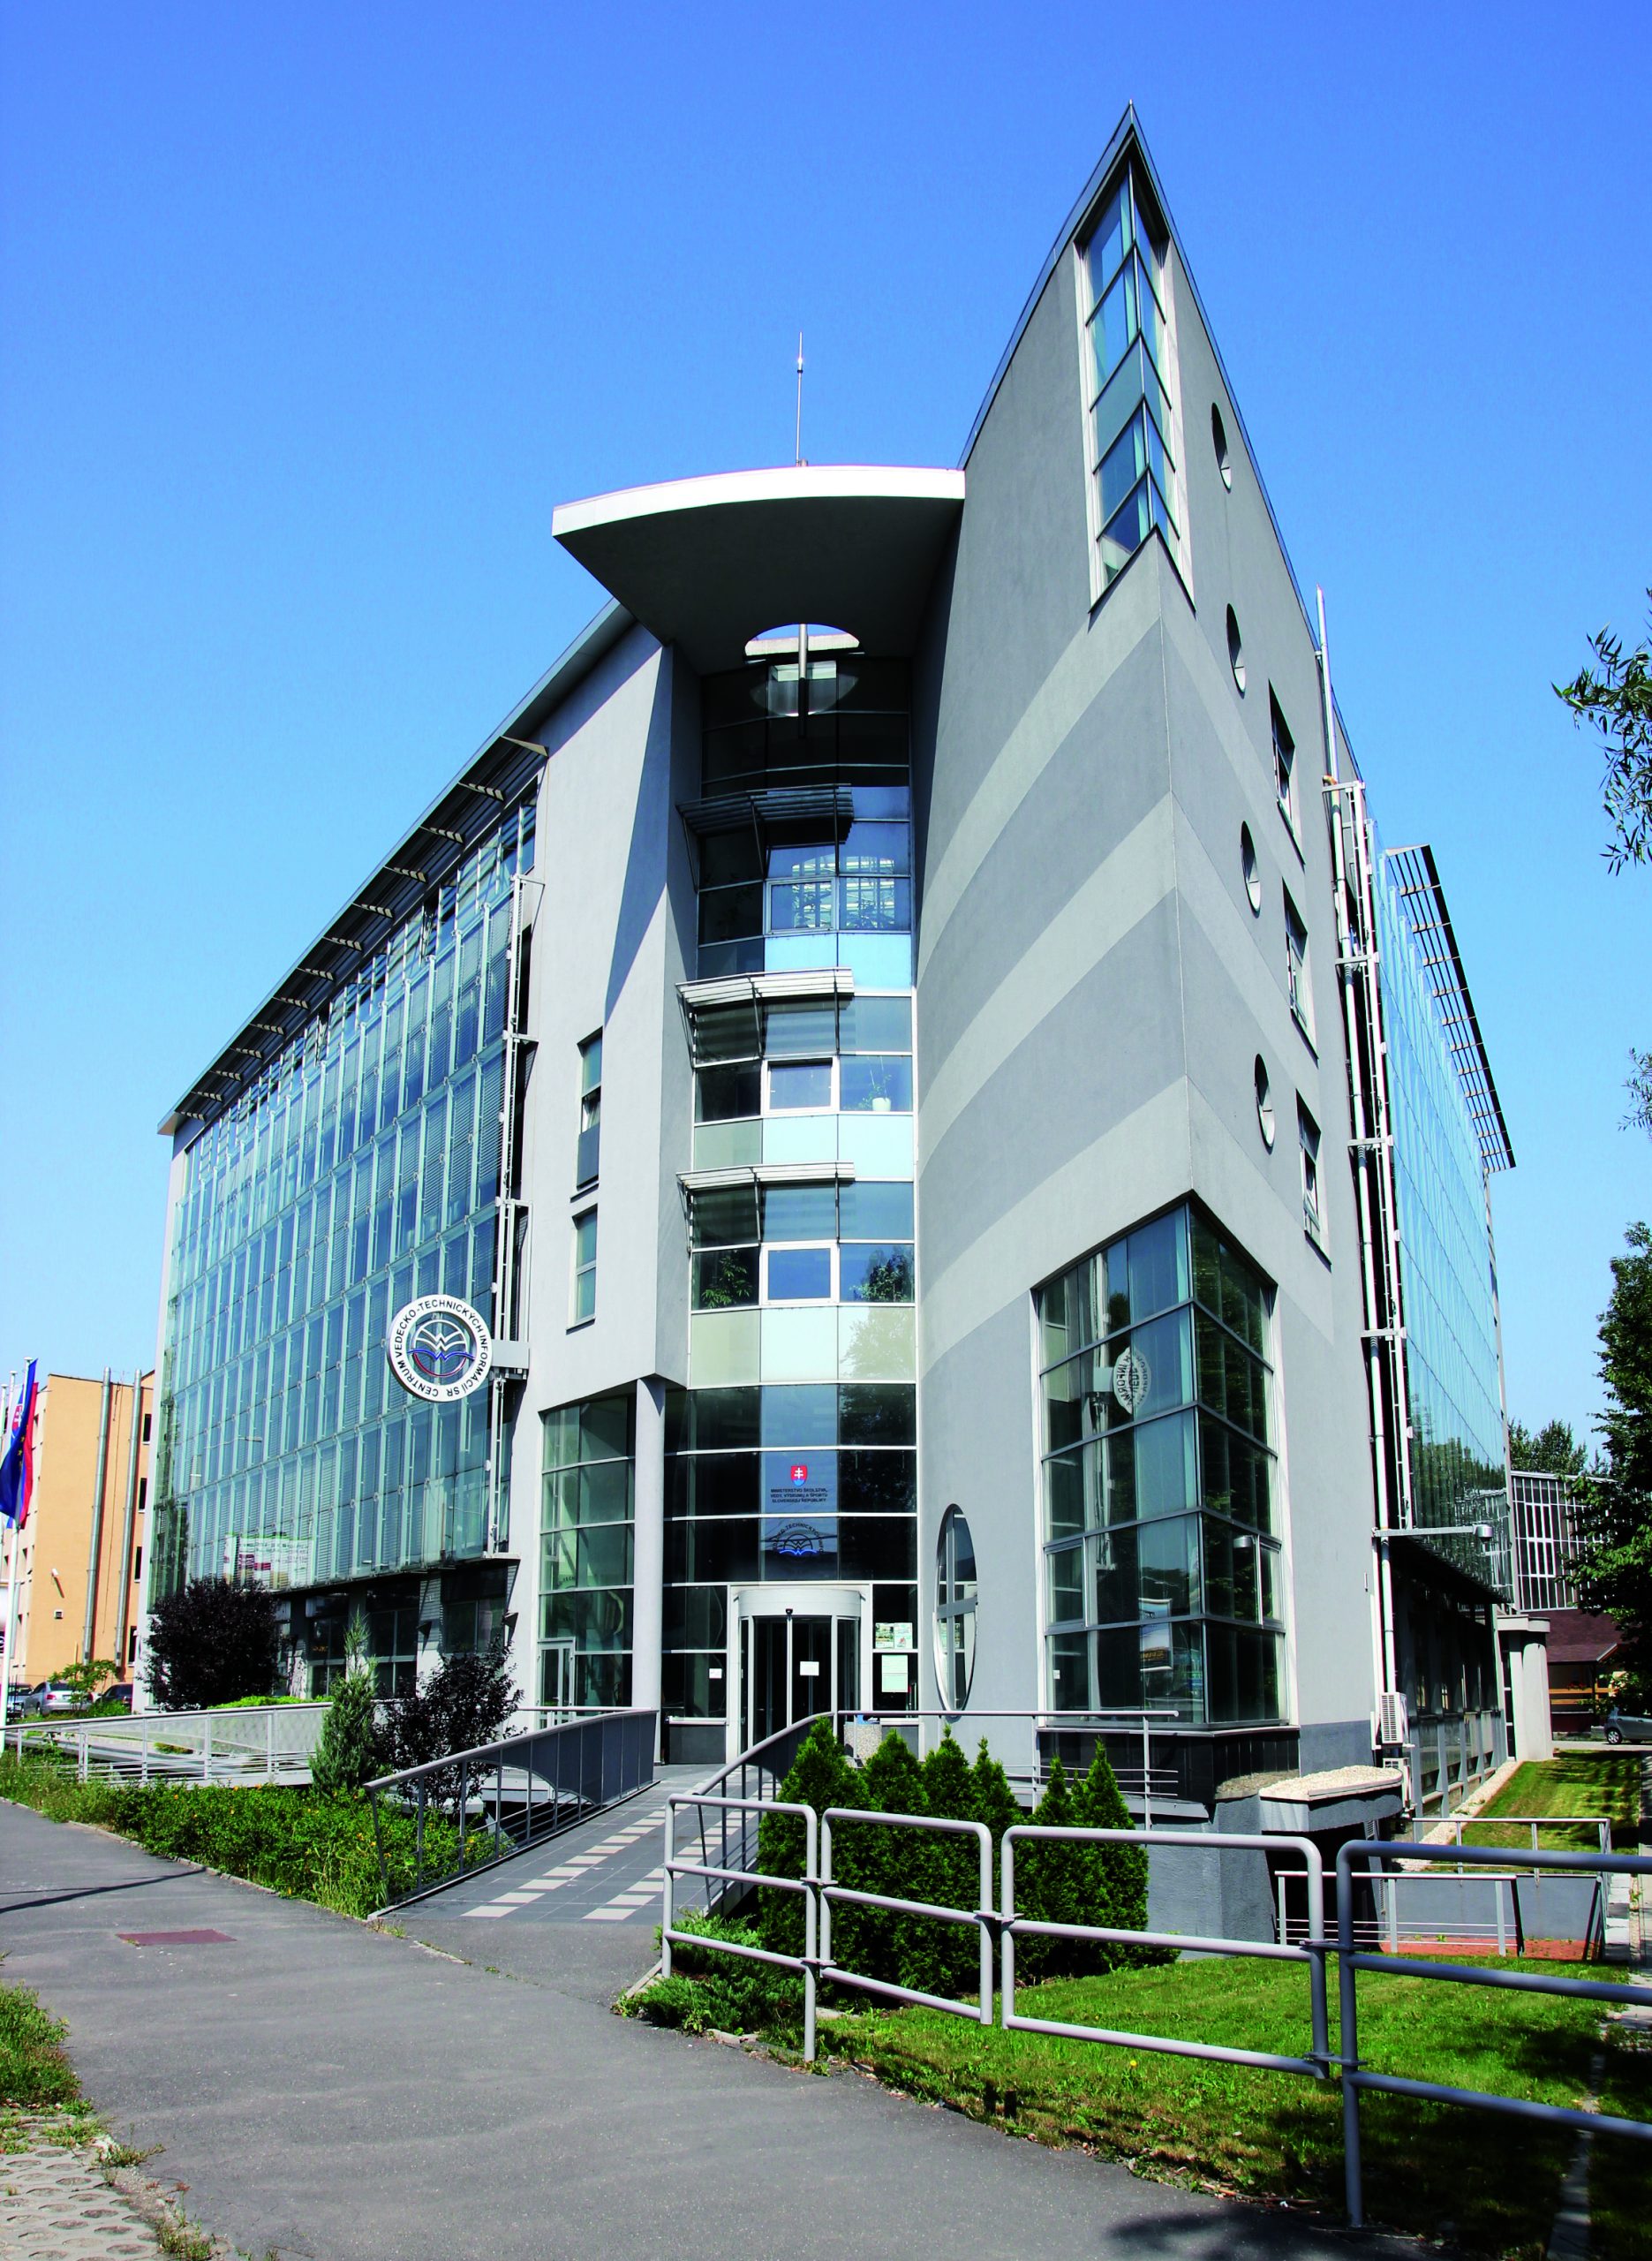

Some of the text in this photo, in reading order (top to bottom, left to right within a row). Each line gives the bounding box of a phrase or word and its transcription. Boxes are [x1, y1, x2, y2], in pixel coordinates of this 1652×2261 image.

[395, 1298, 484, 1358] VEDECKO-TECHNICKÝCH
[396, 1359, 439, 1397] CENTRUM
[447, 1386, 460, 1397] SR
